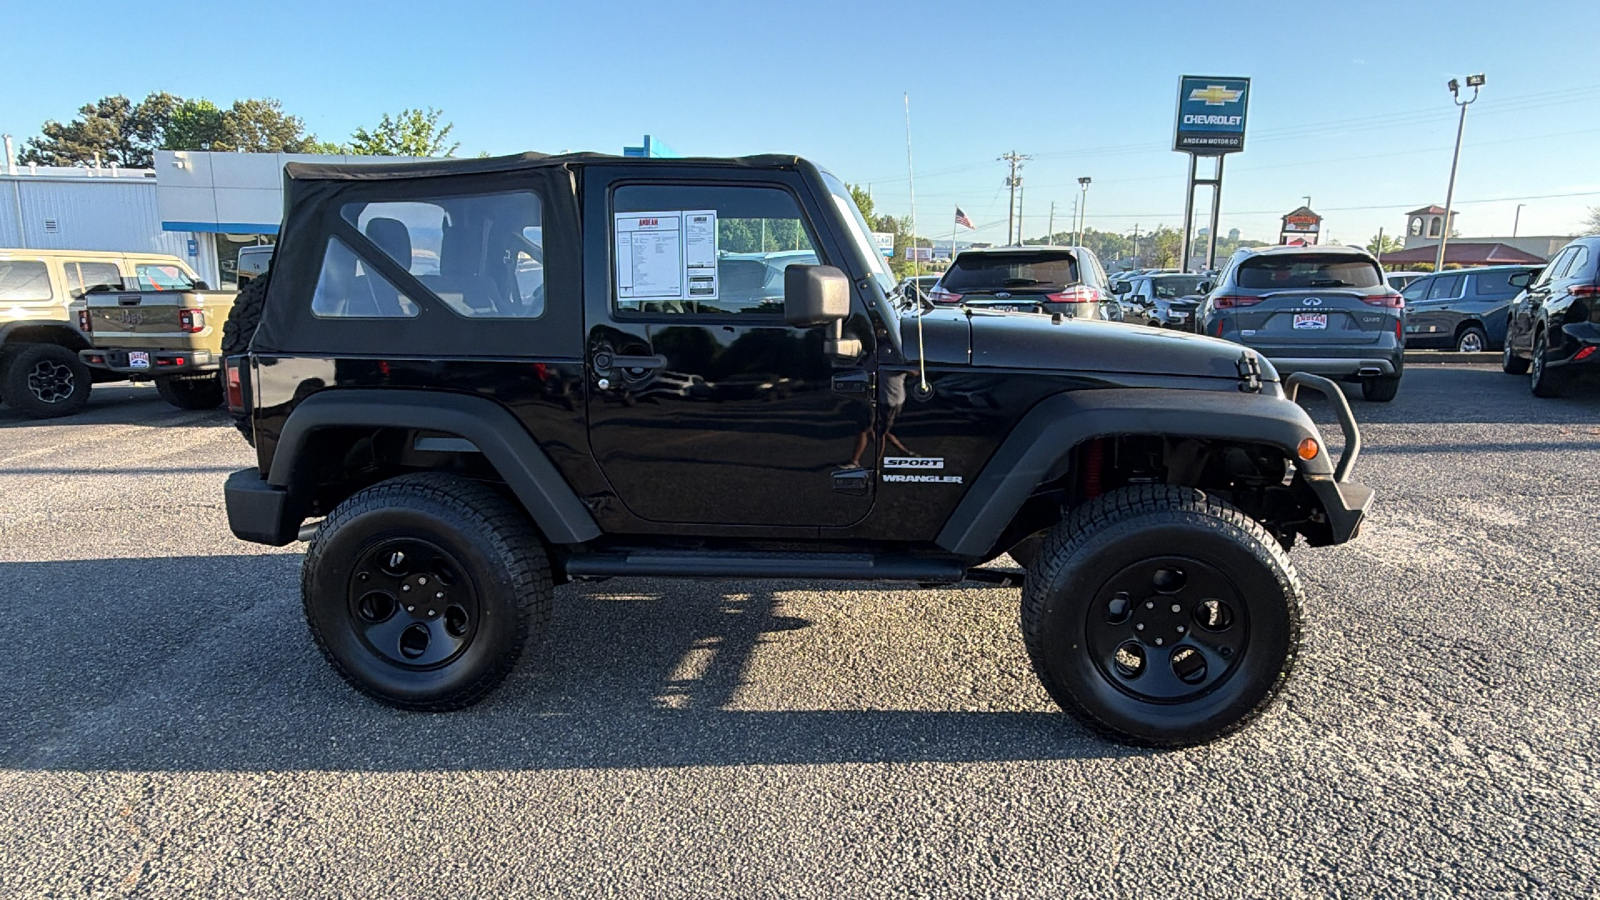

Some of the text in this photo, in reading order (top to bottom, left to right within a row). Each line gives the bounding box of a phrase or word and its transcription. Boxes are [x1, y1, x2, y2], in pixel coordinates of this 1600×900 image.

[1184, 114, 1242, 126] CHEVROLET
[638, 218, 659, 227] ANDEAN
[1295, 314, 1326, 324] ANDEAN
[887, 459, 940, 467] SPORT
[882, 474, 963, 484] WRANGLER
